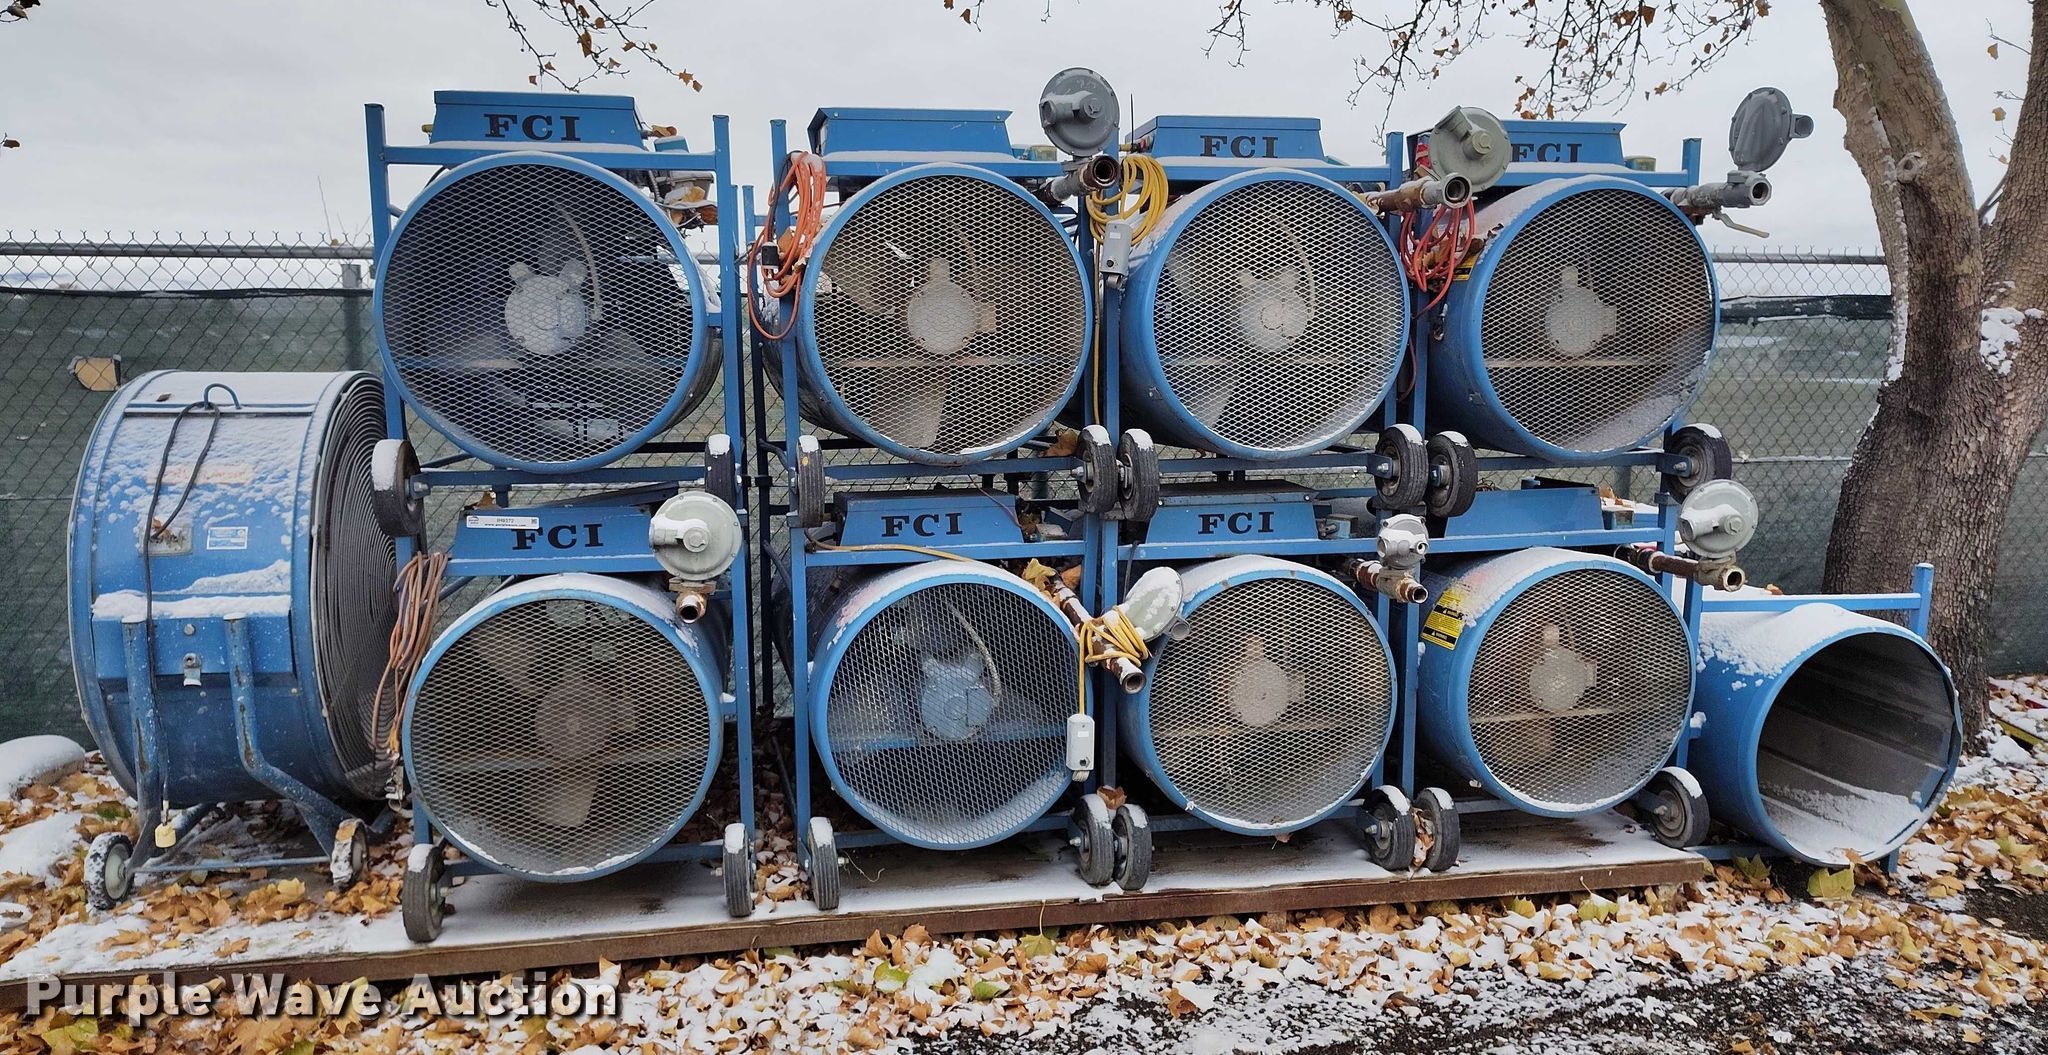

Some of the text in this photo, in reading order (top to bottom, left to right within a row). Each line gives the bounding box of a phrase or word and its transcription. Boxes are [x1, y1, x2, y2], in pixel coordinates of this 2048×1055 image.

[484, 113, 581, 141] FCI
[1200, 135, 1279, 158] FCI
[1509, 143, 1582, 162] FCI
[880, 512, 963, 537] FCI
[1198, 511, 1275, 534] FCI
[511, 523, 604, 550] FCI
